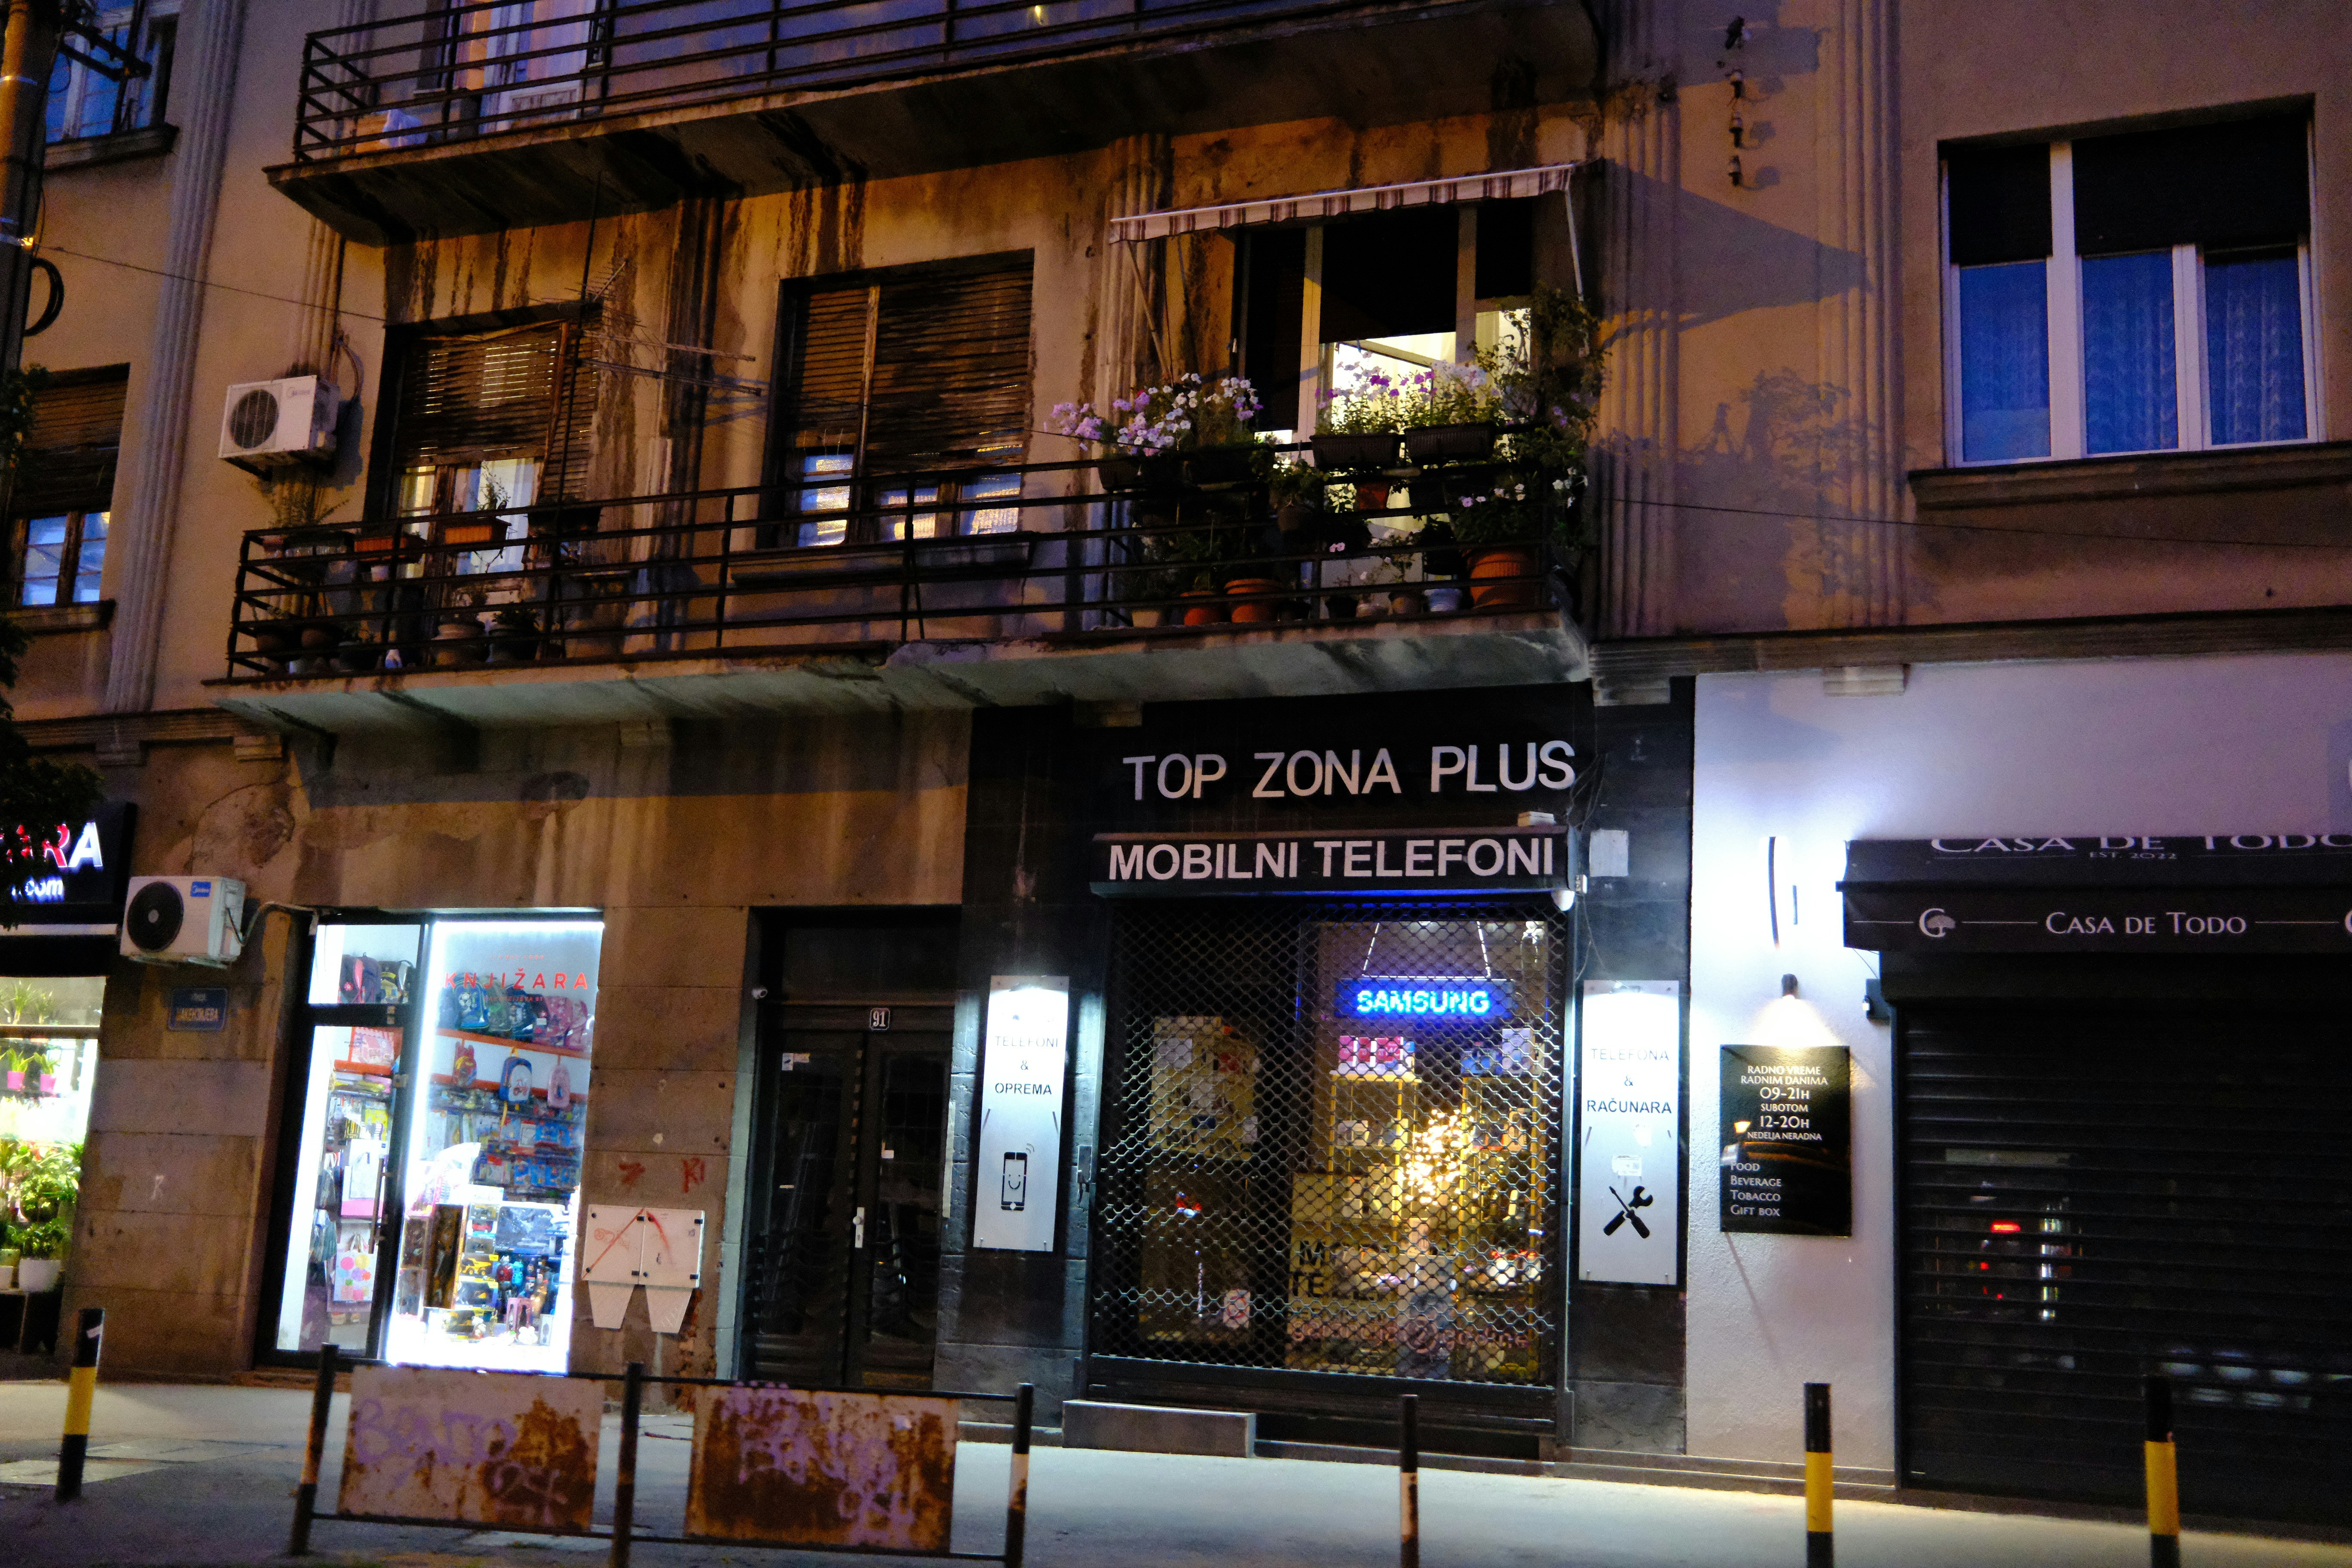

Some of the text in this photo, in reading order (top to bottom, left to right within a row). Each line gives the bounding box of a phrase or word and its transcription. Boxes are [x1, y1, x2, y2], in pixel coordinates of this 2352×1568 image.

[1122, 739, 1576, 801] TOP ZONA PLUS
[1109, 837, 1553, 881] MOBILNI TELEFONI
[2046, 911, 2247, 934] CASA DE TODO
[444, 968, 588, 989] KNJIŽARA
[1357, 990, 1490, 1014] SAMSUNG
[873, 1011, 886, 1027] 91
[995, 1035, 1058, 1047] TELEFONI
[1591, 1048, 1669, 1061] TELEFONA
[1020, 1060, 1029, 1070] &
[1748, 1066, 1821, 1075] RADNO VREME
[1624, 1075, 1633, 1086] &
[1741, 1075, 1828, 1085] RADNIM DANIMA
[995, 1083, 1052, 1095] OPREMA
[1760, 1087, 1810, 1100] 09-21H
[1587, 1097, 1672, 1114] RAČUNARA
[1761, 1103, 1809, 1112] SUBOTOM
[1760, 1115, 1810, 1129] 12-20H
[1747, 1131, 1822, 1141] NEDELJA NERADNA
[1730, 1161, 1761, 1171] FOOD
[1730, 1175, 1782, 1187] BEVERAGE
[1730, 1189, 1781, 1201] TOBACCO
[1730, 1204, 1755, 1215] GIFT
